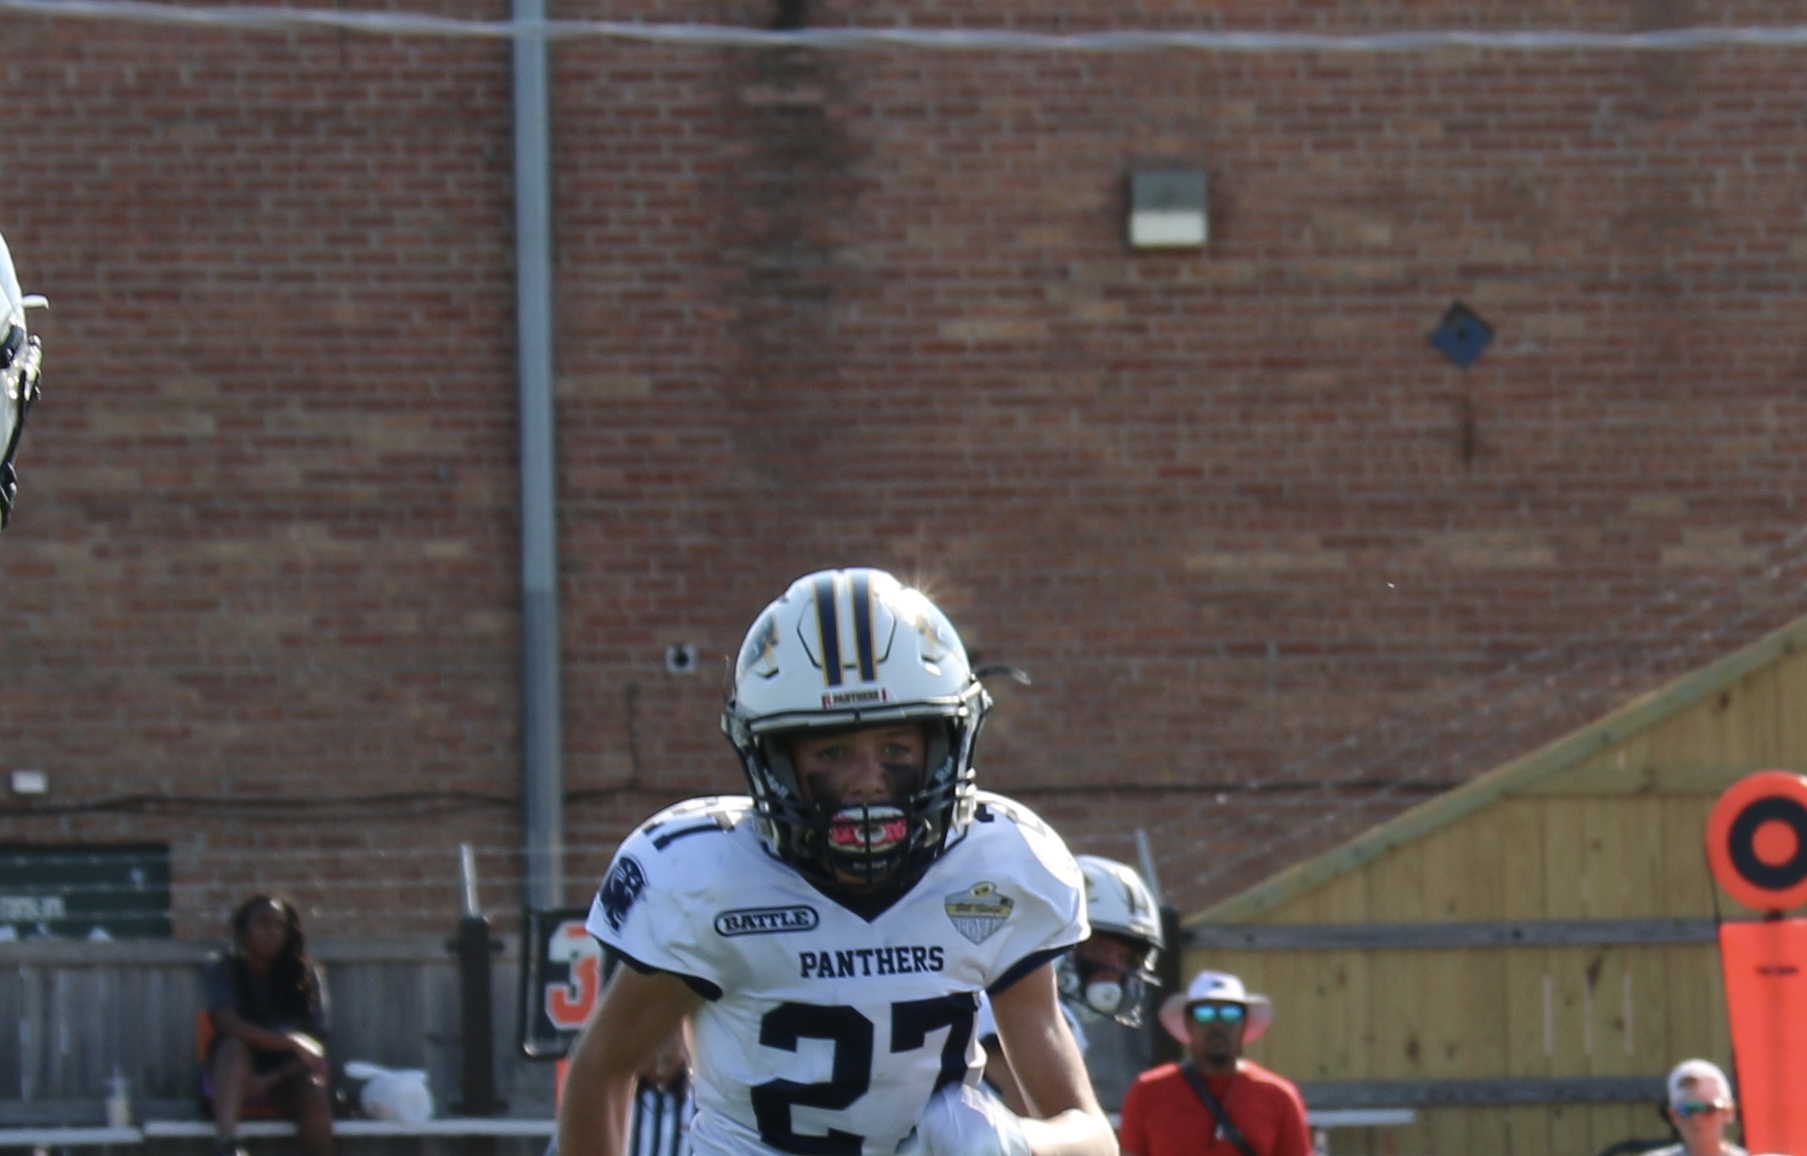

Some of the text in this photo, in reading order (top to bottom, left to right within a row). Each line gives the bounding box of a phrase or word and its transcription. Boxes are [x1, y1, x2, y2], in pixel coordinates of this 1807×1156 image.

[723, 910, 810, 931] BATTLE
[544, 920, 604, 1030] 3
[799, 946, 944, 978] PANTHERS
